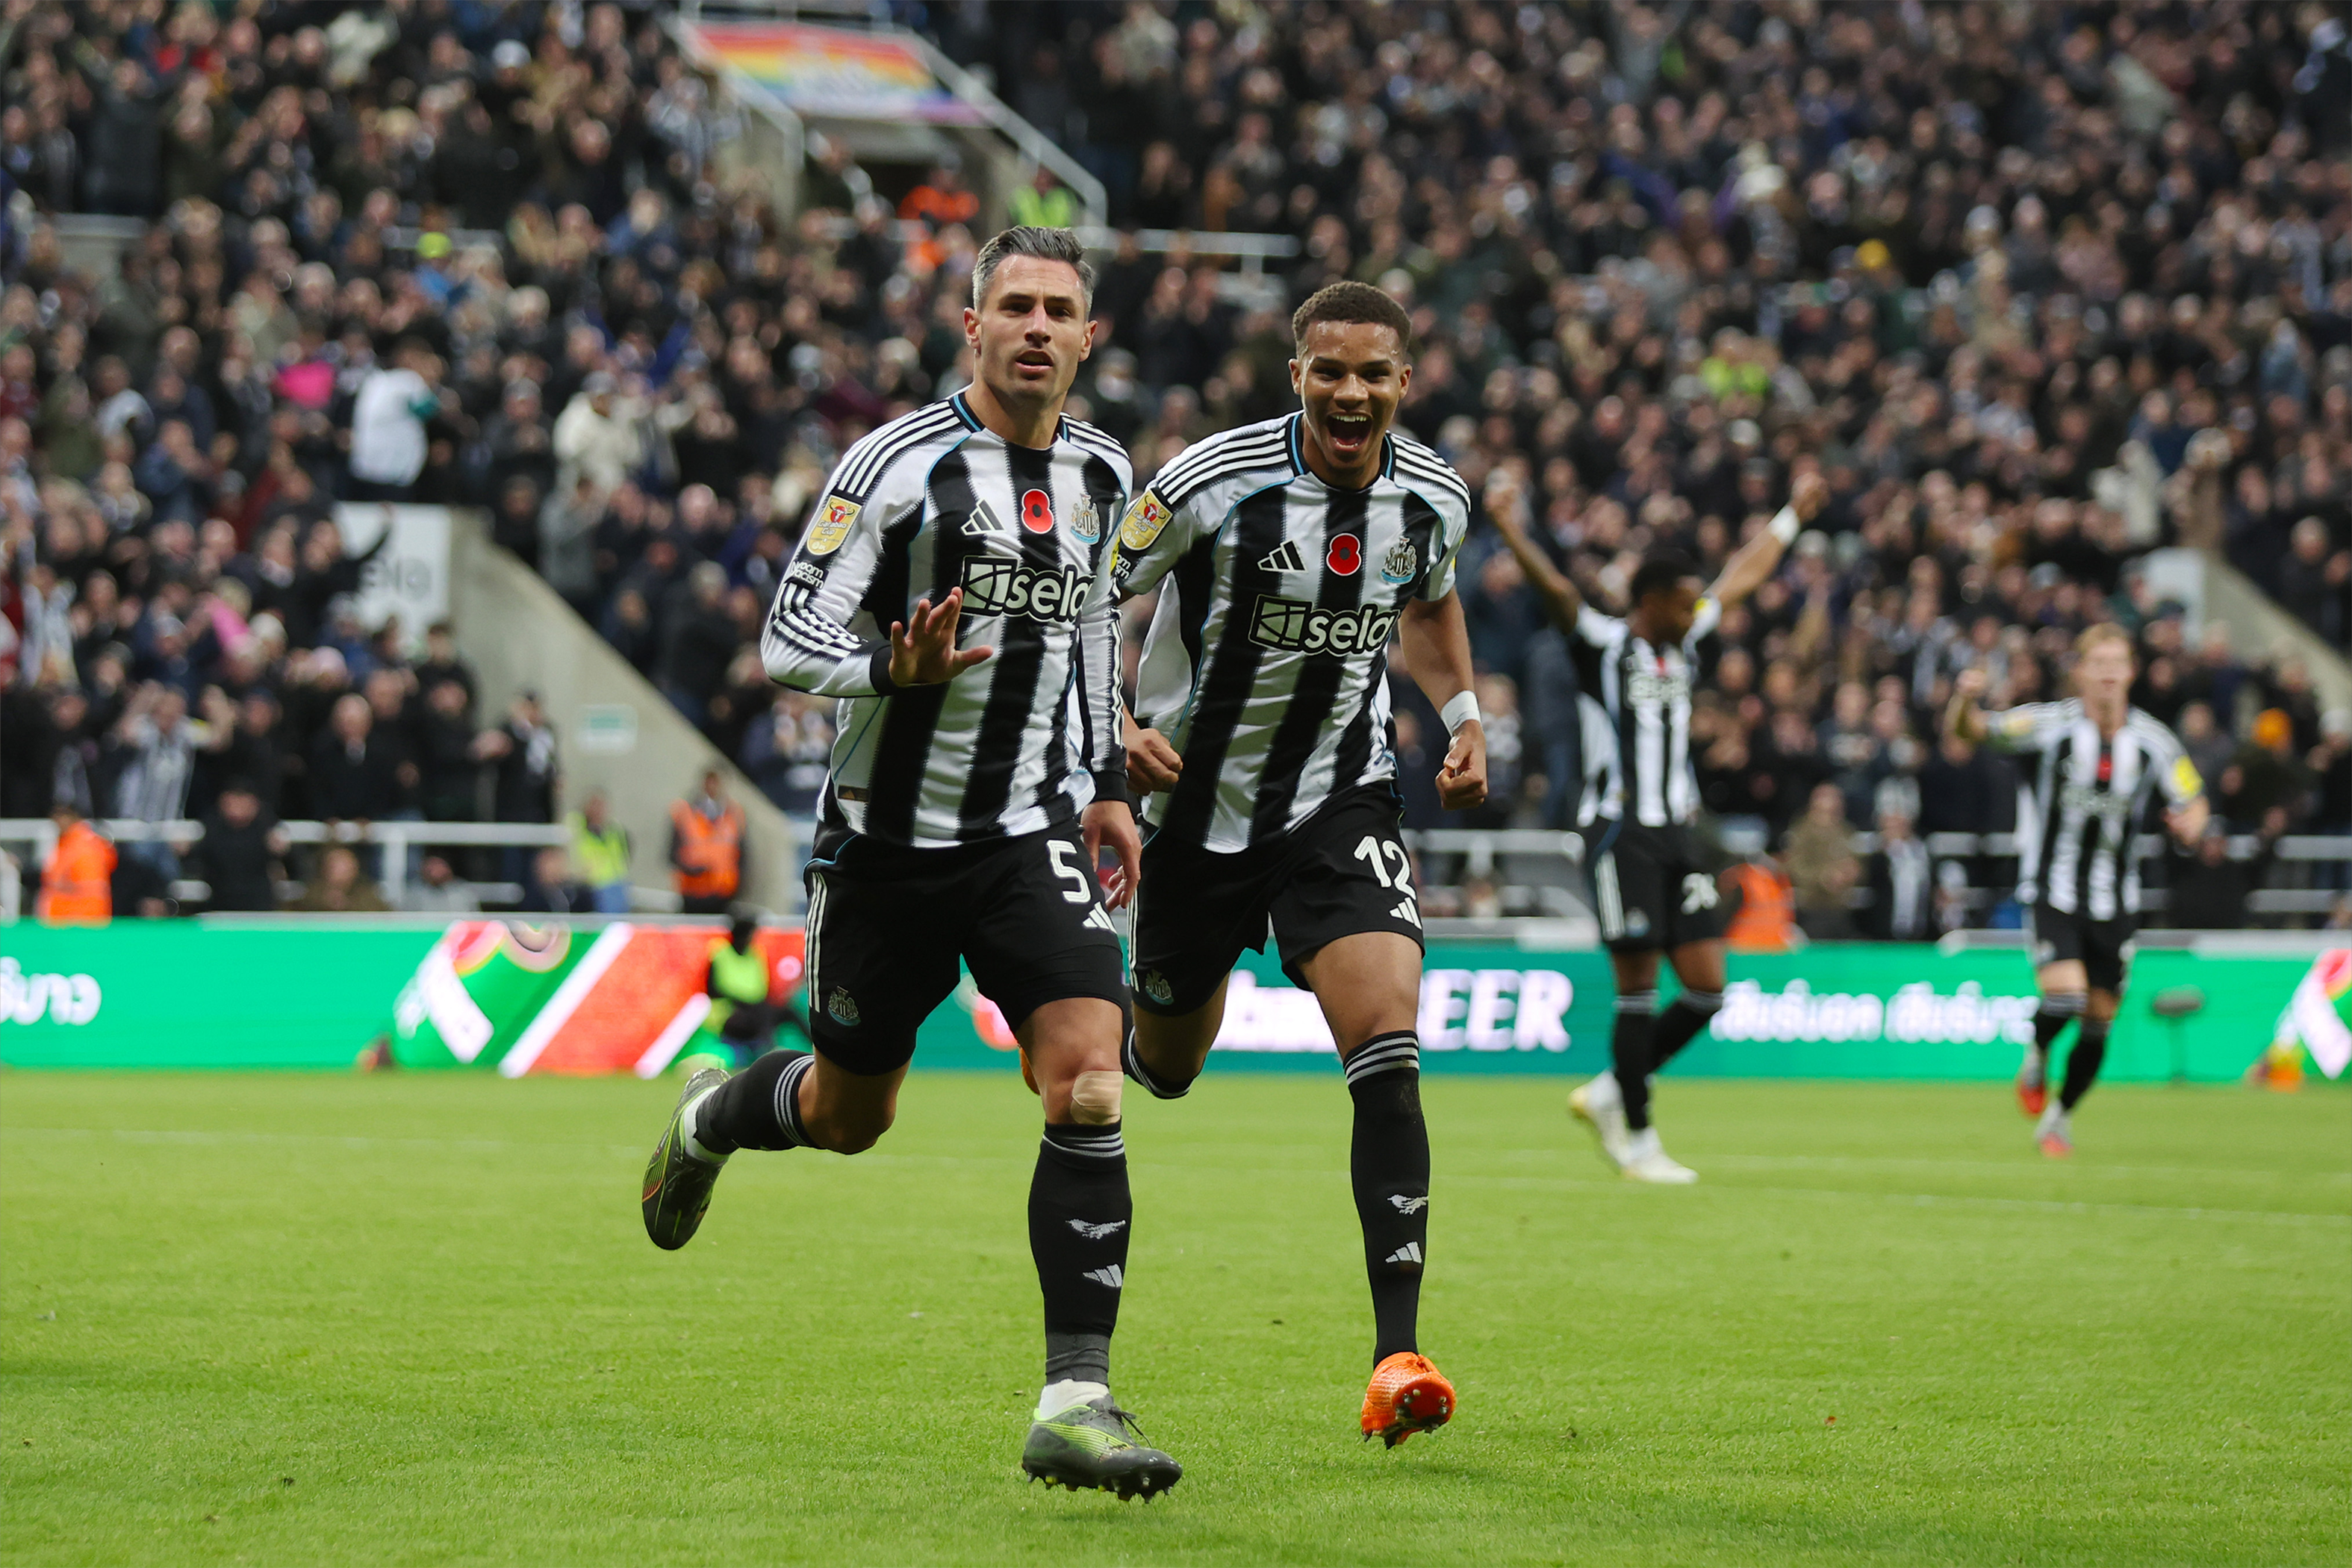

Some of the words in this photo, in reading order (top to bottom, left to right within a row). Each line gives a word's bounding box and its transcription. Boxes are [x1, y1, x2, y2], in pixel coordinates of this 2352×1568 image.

[817, 520, 847, 529] Carabao
[821, 527, 836, 536] Cup
[1132, 510, 1159, 531] Carabao
[1133, 520, 1148, 532] Cup
[1304, 609, 1396, 650] sela
[1046, 839, 1091, 903] 5
[1354, 835, 1416, 900] 12
[1416, 968, 1574, 1052] EER
